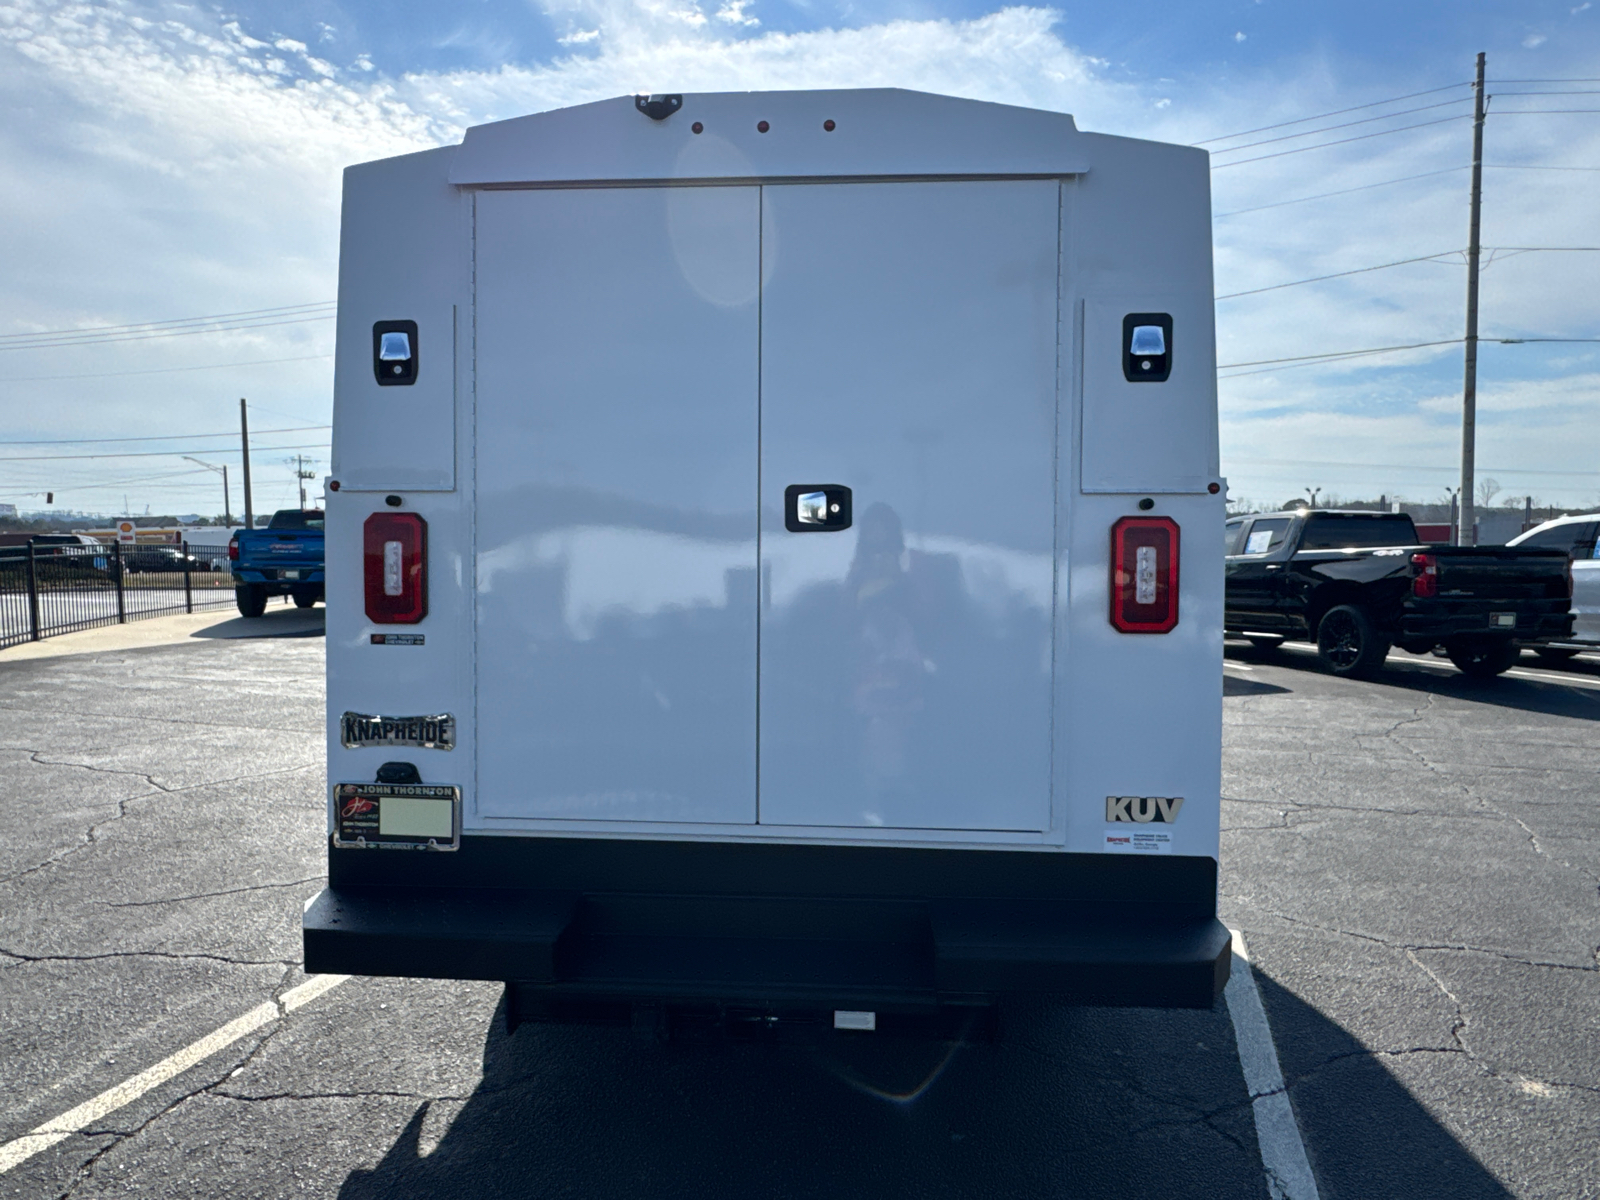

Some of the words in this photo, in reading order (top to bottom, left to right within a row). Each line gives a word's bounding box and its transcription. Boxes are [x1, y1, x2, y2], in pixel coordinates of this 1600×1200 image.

[345, 717, 449, 745] KNAPHEIDE
[363, 785, 392, 794] JOHN
[394, 786, 452, 796] THORNTON
[1106, 796, 1184, 823] KUV
